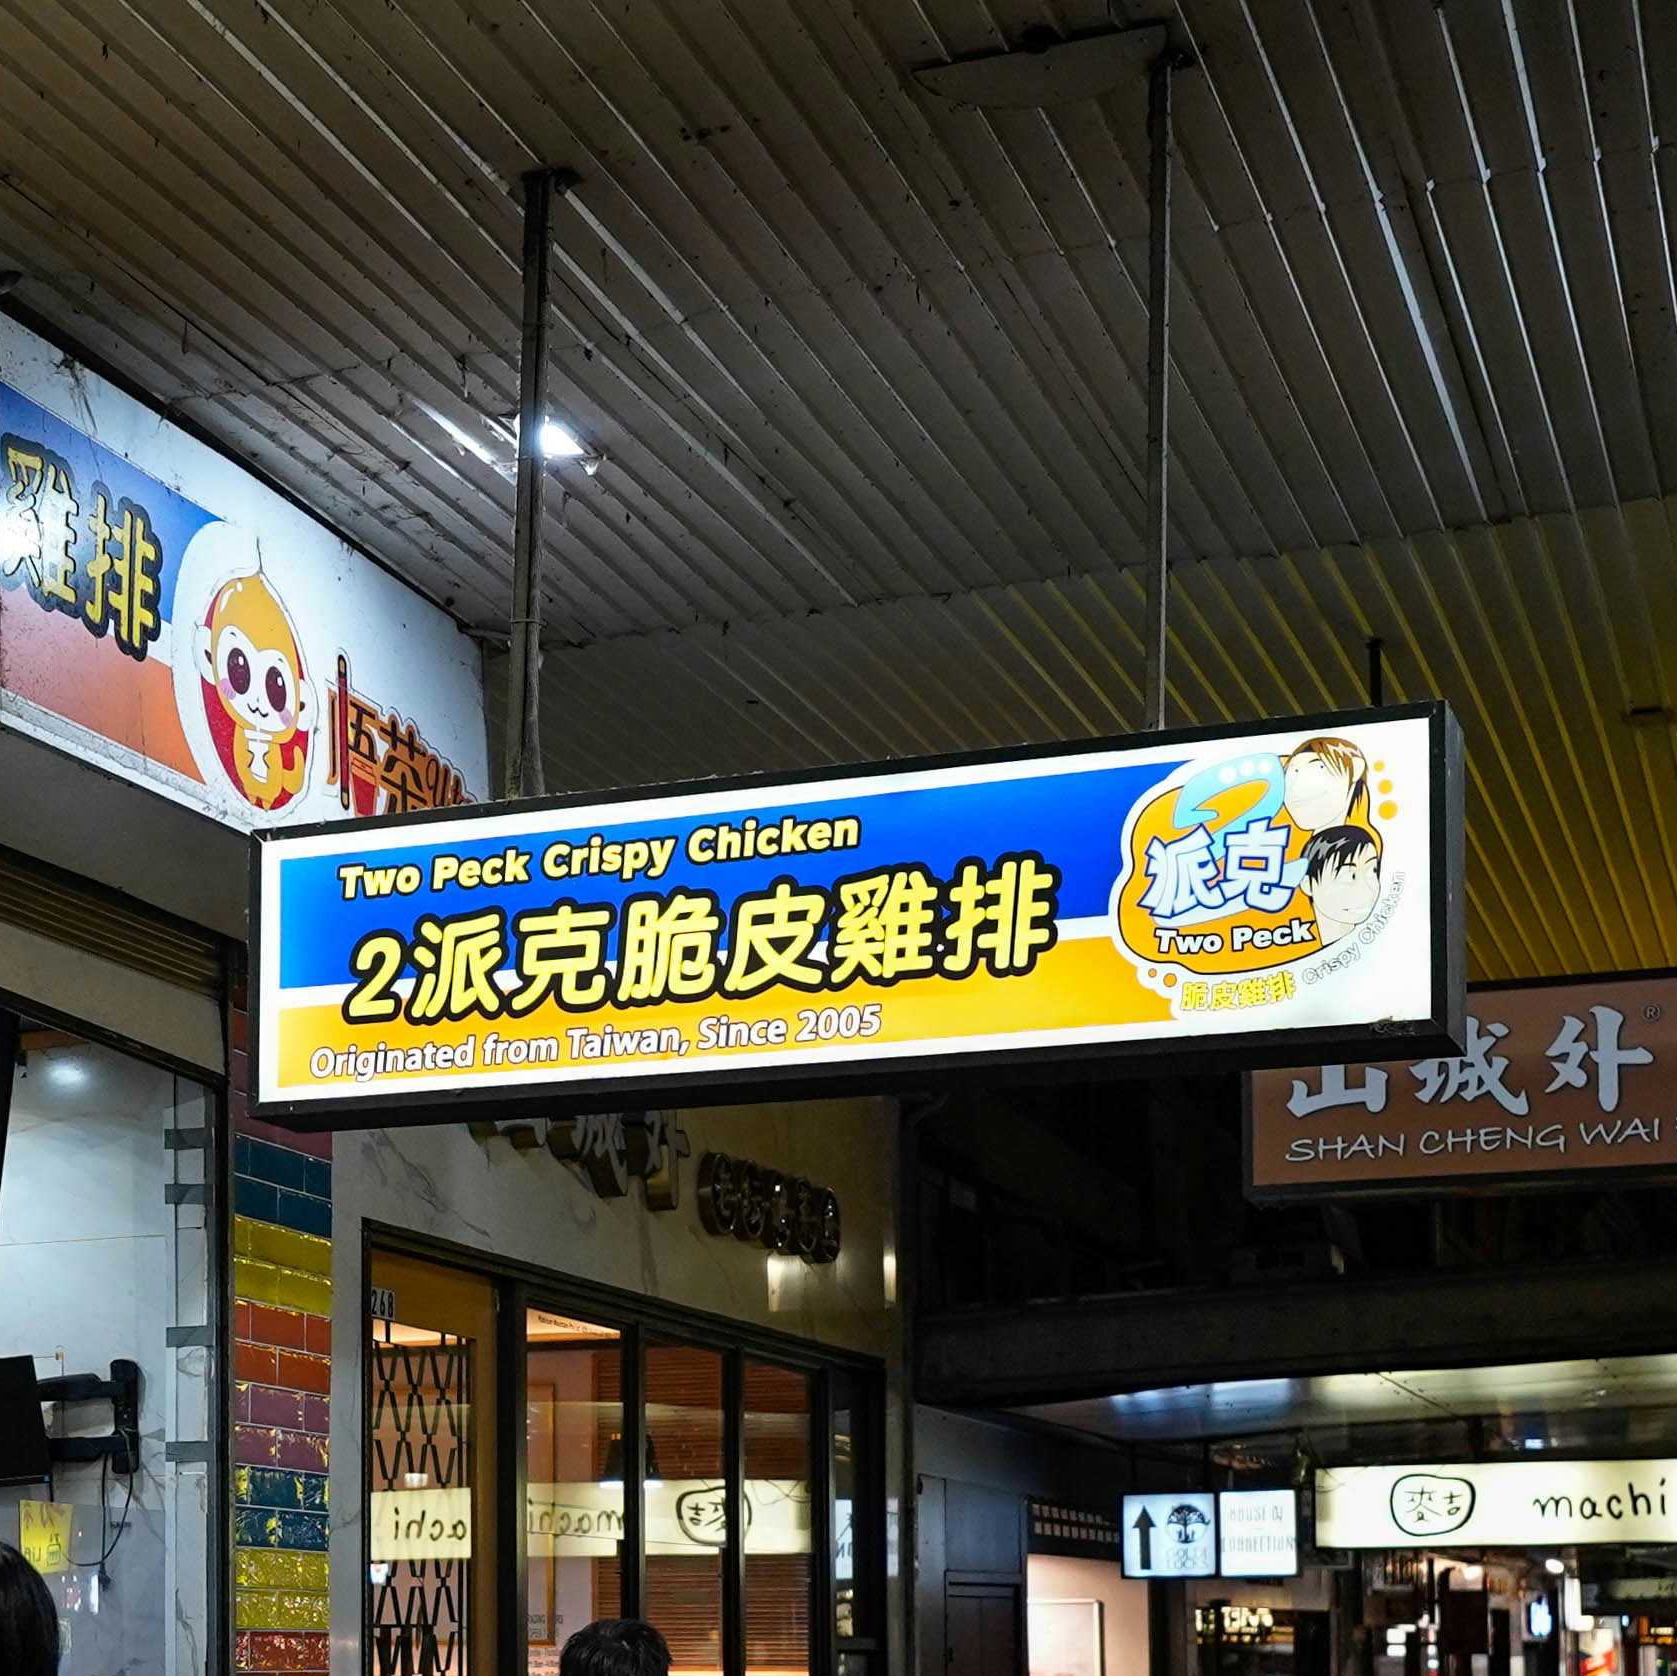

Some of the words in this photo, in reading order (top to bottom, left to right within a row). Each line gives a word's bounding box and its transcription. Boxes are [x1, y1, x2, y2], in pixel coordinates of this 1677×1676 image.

[338, 864, 421, 901] Two
[430, 846, 531, 892] Peck
[542, 834, 677, 882] Crispy
[687, 813, 861, 864] Chicken
[1141, 819, 1300, 918] 派克
[346, 857, 1055, 1020] 2派克脆皮雞排
[1155, 926, 1224, 955] Two
[1231, 917, 1315, 953] Peck
[1301, 943, 1361, 986] Crispy
[1357, 869, 1406, 947] Chicken
[309, 1042, 474, 1084] Originated
[482, 1034, 559, 1067] from
[567, 1024, 690, 1062] Taiwan,
[698, 1016, 786, 1048] Since
[794, 1003, 882, 1043] 2005
[1285, 1134, 1406, 1164] SHAN
[1418, 1122, 1567, 1159] CHENG
[1579, 1115, 1662, 1147] WAI
[1532, 1477, 1669, 1523] machi
